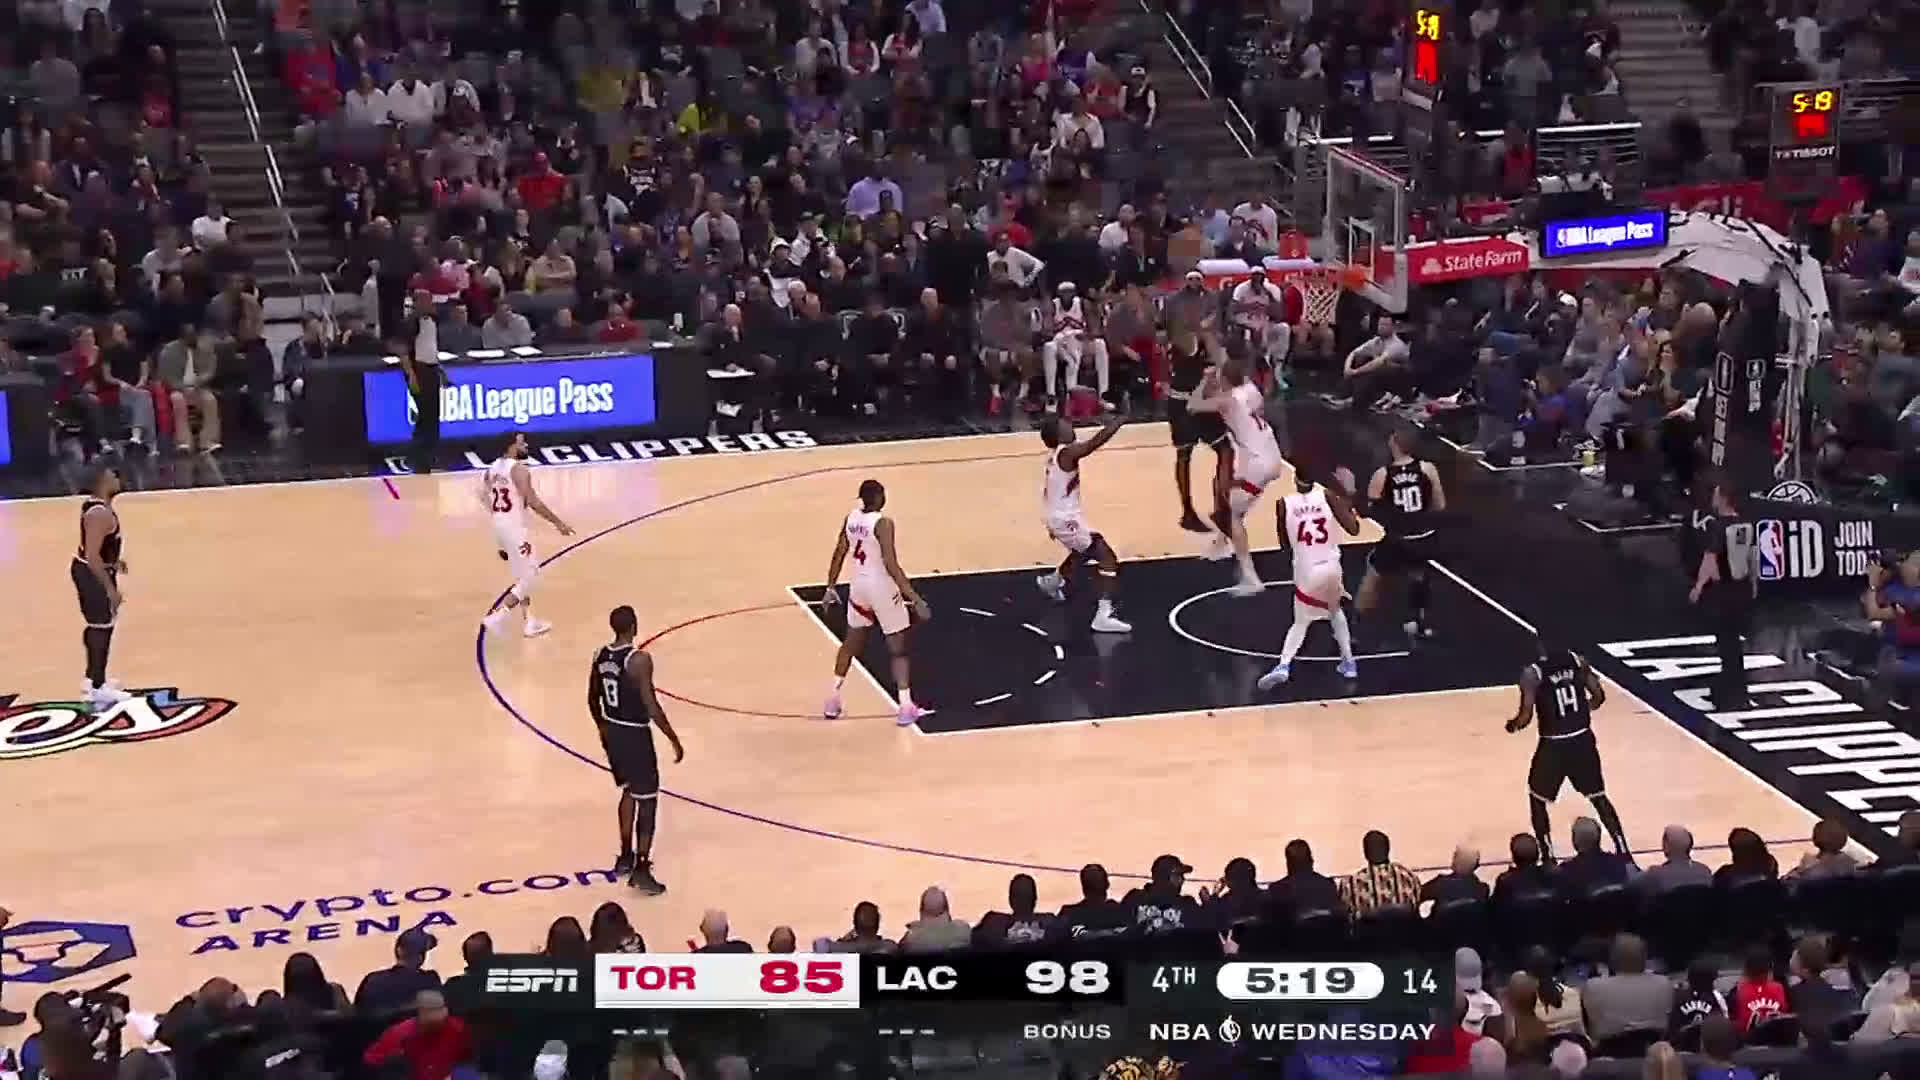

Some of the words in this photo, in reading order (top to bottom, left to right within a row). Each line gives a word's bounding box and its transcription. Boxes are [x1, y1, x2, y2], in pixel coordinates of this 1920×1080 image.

[1627, 220, 1653, 240] Pass
[475, 383, 556, 424] League
[559, 377, 614, 414] Pass
[540, 429, 819, 466] CLIPPERS
[492, 488, 512, 513] 23
[1393, 485, 1423, 512] 40
[1298, 517, 1329, 546] 43
[1834, 521, 1873, 548] JOIN
[853, 539, 867, 566] 4
[1789, 520, 1825, 578] iD
[1835, 550, 1880, 576] TOD
[1556, 684, 1579, 717] 14
[189, 911, 458, 955] ARENA
